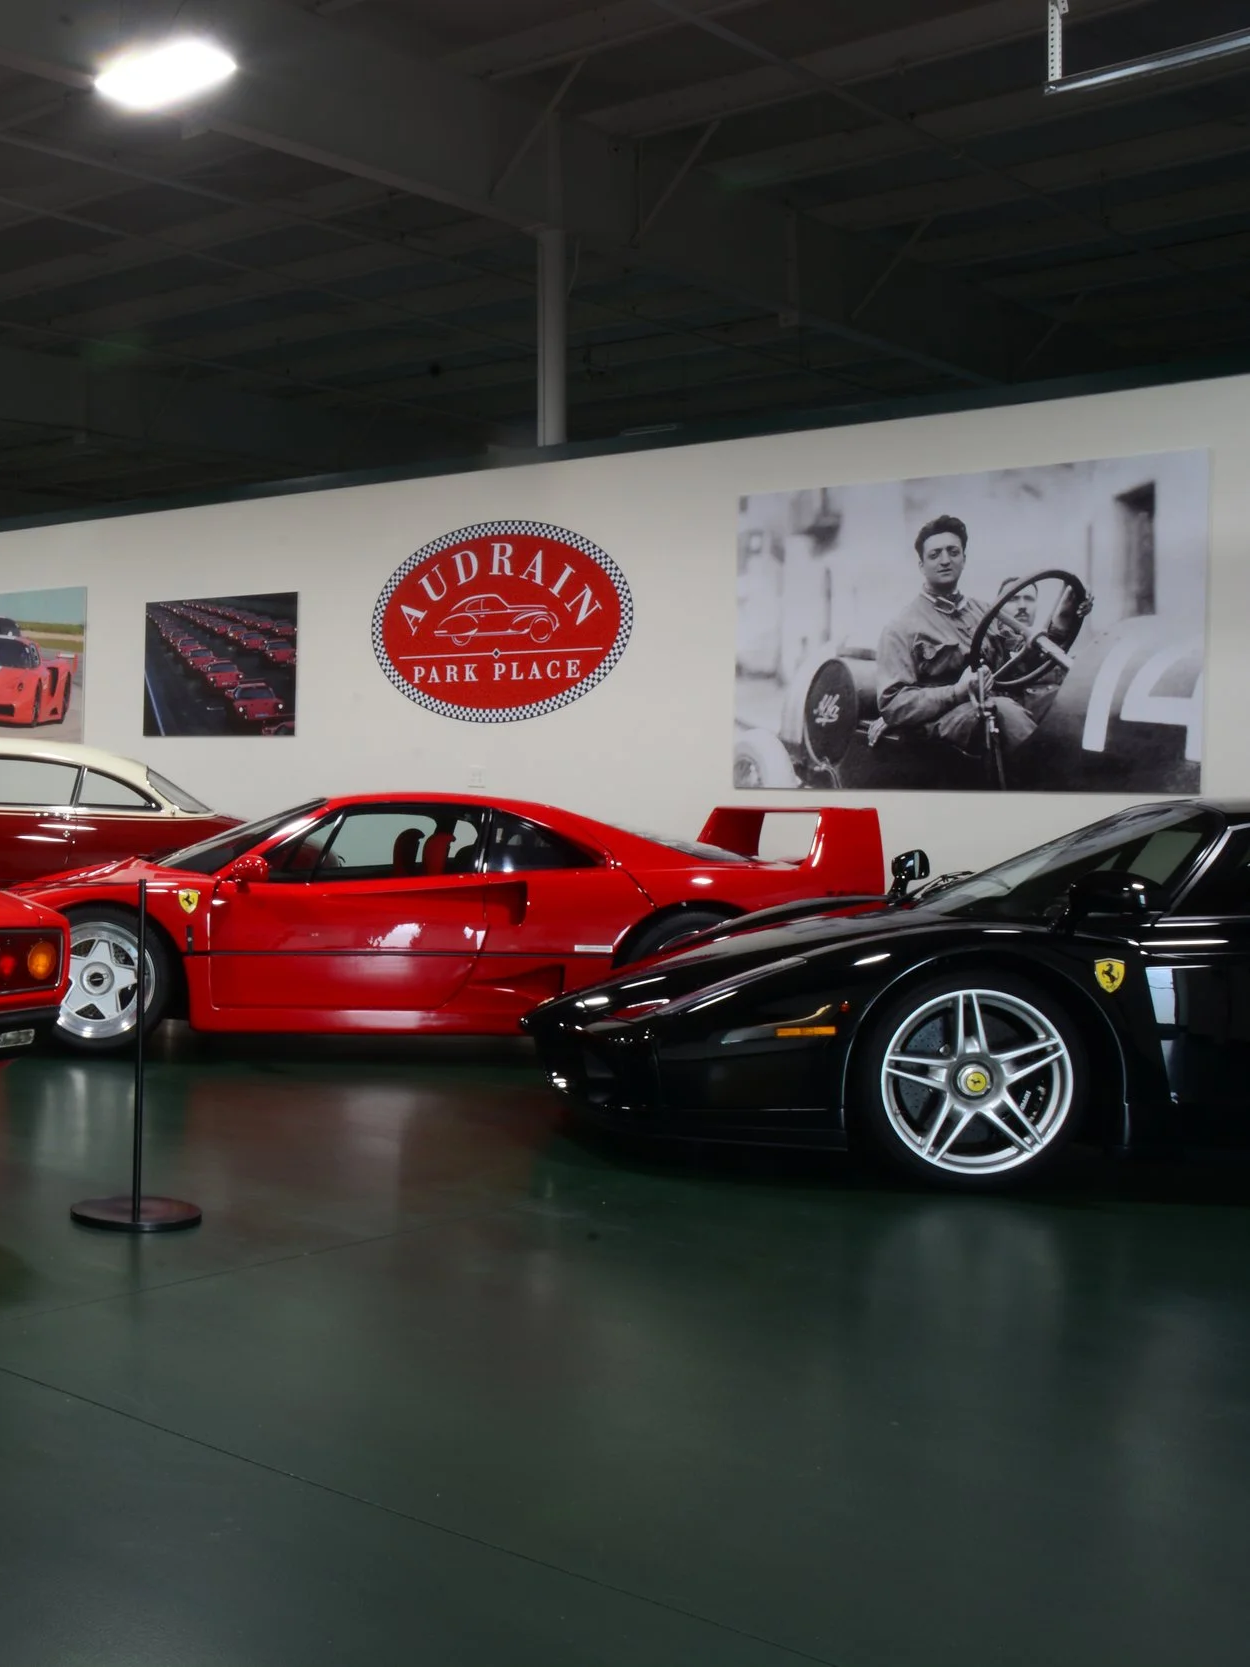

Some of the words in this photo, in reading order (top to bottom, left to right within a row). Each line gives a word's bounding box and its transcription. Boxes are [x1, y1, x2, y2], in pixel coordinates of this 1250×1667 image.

[400, 542, 603, 636] AUDRAIN
[412, 663, 479, 684] PARK
[493, 659, 581, 681] PLACE
